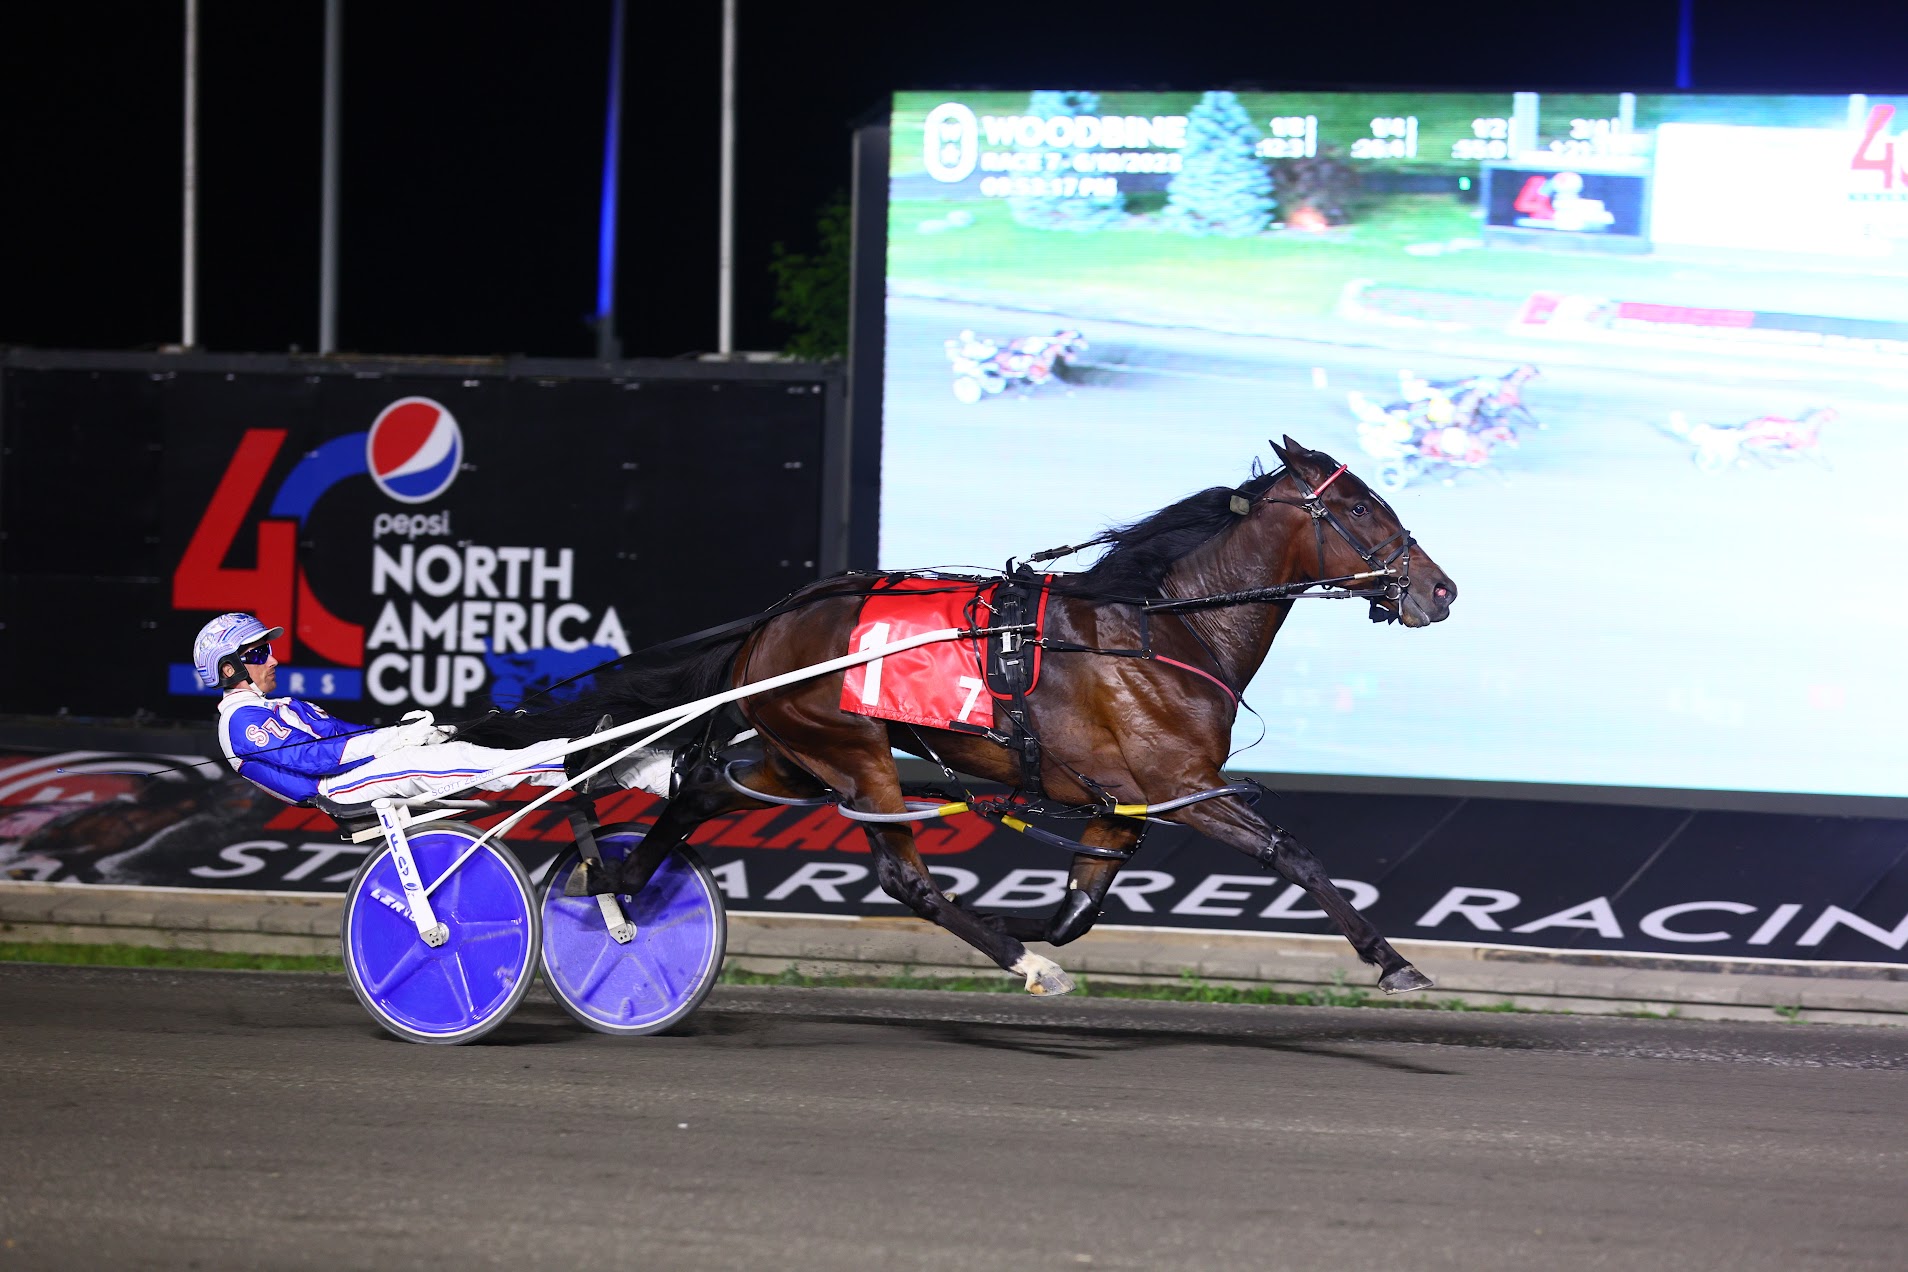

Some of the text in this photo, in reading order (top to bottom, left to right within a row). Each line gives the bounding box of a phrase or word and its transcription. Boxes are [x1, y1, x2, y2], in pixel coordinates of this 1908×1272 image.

[982, 115, 1188, 148] WOODBINE
[373, 511, 451, 538] pepsi
[371, 544, 574, 600] NORTH
[366, 600, 633, 656] AMERICA
[193, 672, 336, 696] YRS
[366, 652, 487, 707] CUP
[859, 622, 890, 706] 1
[957, 676, 983, 721] 7
[431, 768, 495, 797] SCOTT ZERON
[189, 839, 1380, 919] STARDBRED
